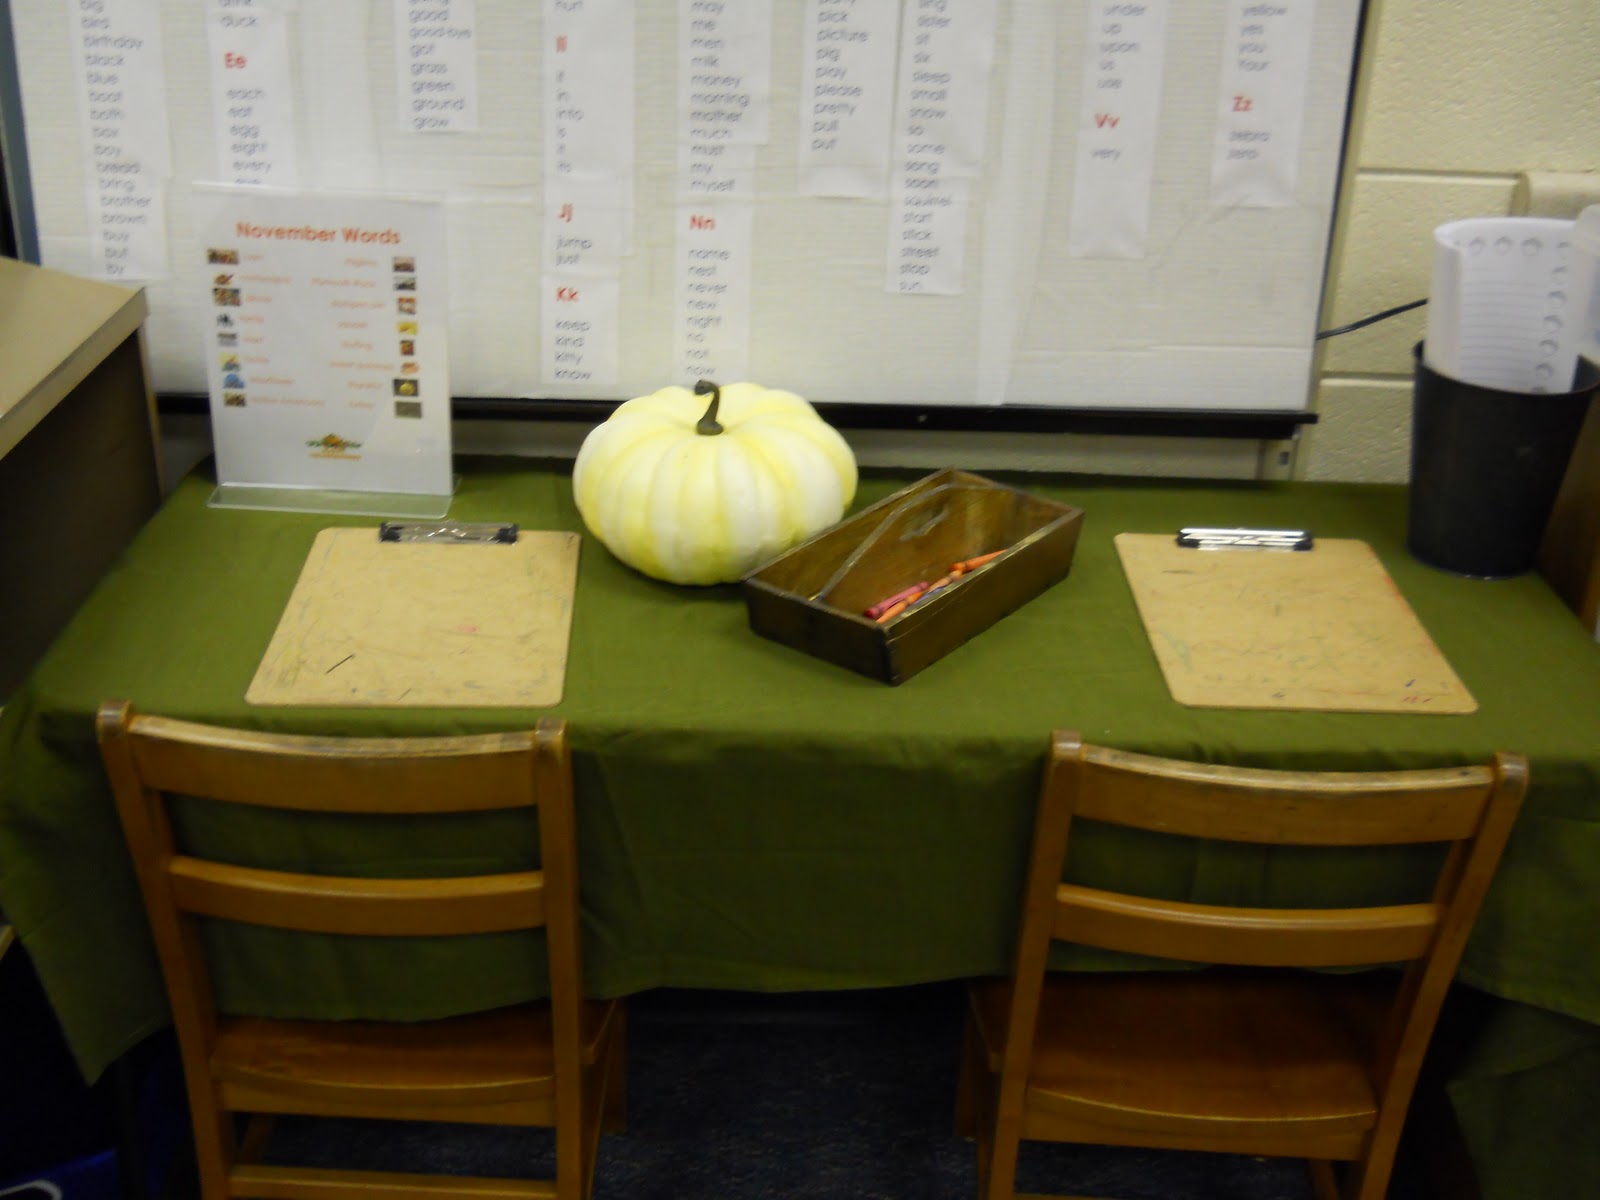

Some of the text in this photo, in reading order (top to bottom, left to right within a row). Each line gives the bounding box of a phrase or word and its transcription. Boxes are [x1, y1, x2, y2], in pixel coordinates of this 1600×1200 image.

[691, 19, 717, 31] me
[816, 29, 869, 43] picture
[224, 52, 247, 69] Ee
[816, 47, 841, 62] pig
[814, 66, 847, 80] play
[411, 79, 454, 94] green
[690, 74, 741, 88] money
[814, 84, 863, 98] please
[412, 98, 465, 112] ground
[1232, 96, 1254, 113] Zz
[690, 110, 742, 123] mother
[1095, 113, 1120, 129] Vv
[690, 163, 712, 175] my
[690, 178, 736, 192] myself
[558, 203, 574, 223] Jj
[690, 215, 716, 230] Nn
[235, 222, 401, 244] November Words
[556, 236, 592, 250] jump
[688, 248, 730, 261] name
[556, 287, 579, 302] Kk
[688, 281, 728, 294] never
[687, 298, 717, 310] new
[554, 320, 590, 332] keep
[686, 314, 722, 329] night
[554, 335, 584, 347] kind
[686, 331, 704, 344] no
[553, 368, 592, 380] know
[685, 364, 716, 376] now
